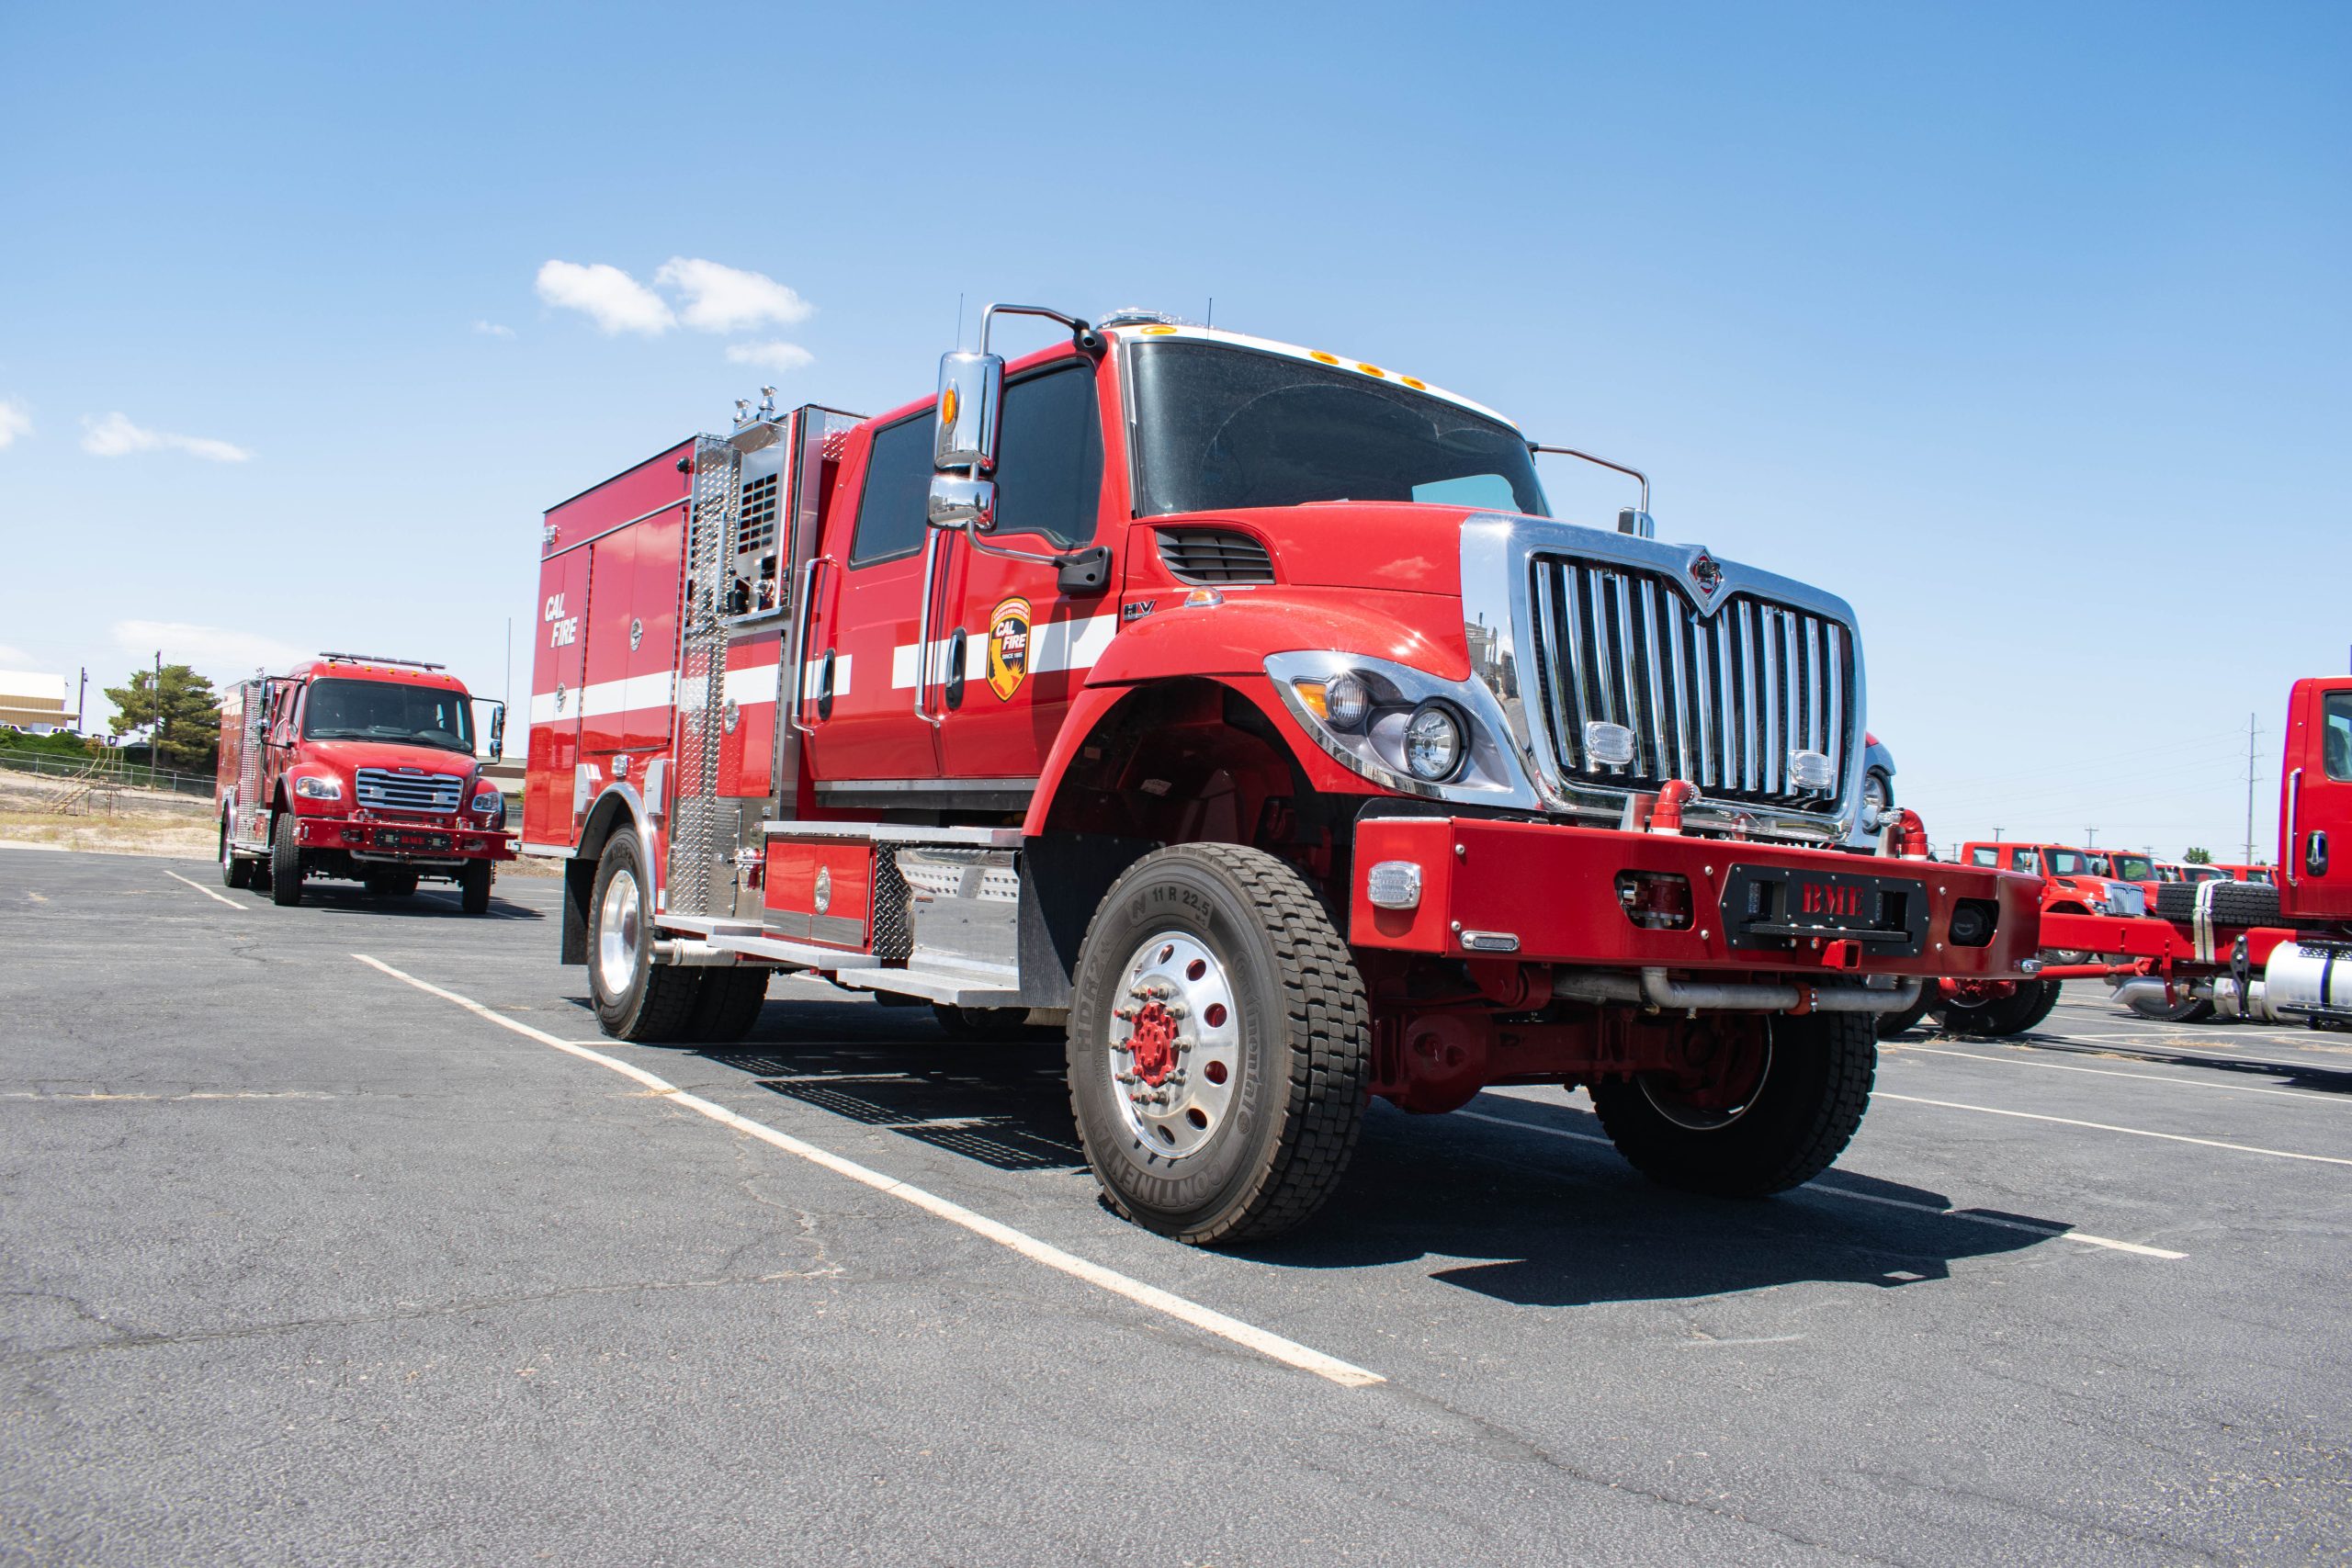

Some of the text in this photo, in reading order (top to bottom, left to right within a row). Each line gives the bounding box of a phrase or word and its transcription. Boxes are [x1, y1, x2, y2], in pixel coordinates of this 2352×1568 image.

[545, 592, 565, 622] CAL
[1124, 600, 1156, 618] HV
[550, 617, 578, 649] FIRE
[996, 620, 1015, 637] CAL
[1002, 634, 1026, 649] FIRE
[1152, 886, 1163, 902] 11
[1169, 886, 1177, 901] R
[1182, 890, 1210, 917] 22.5
[1802, 882, 1864, 917] BME
[1233, 950, 1262, 1114] Continental
